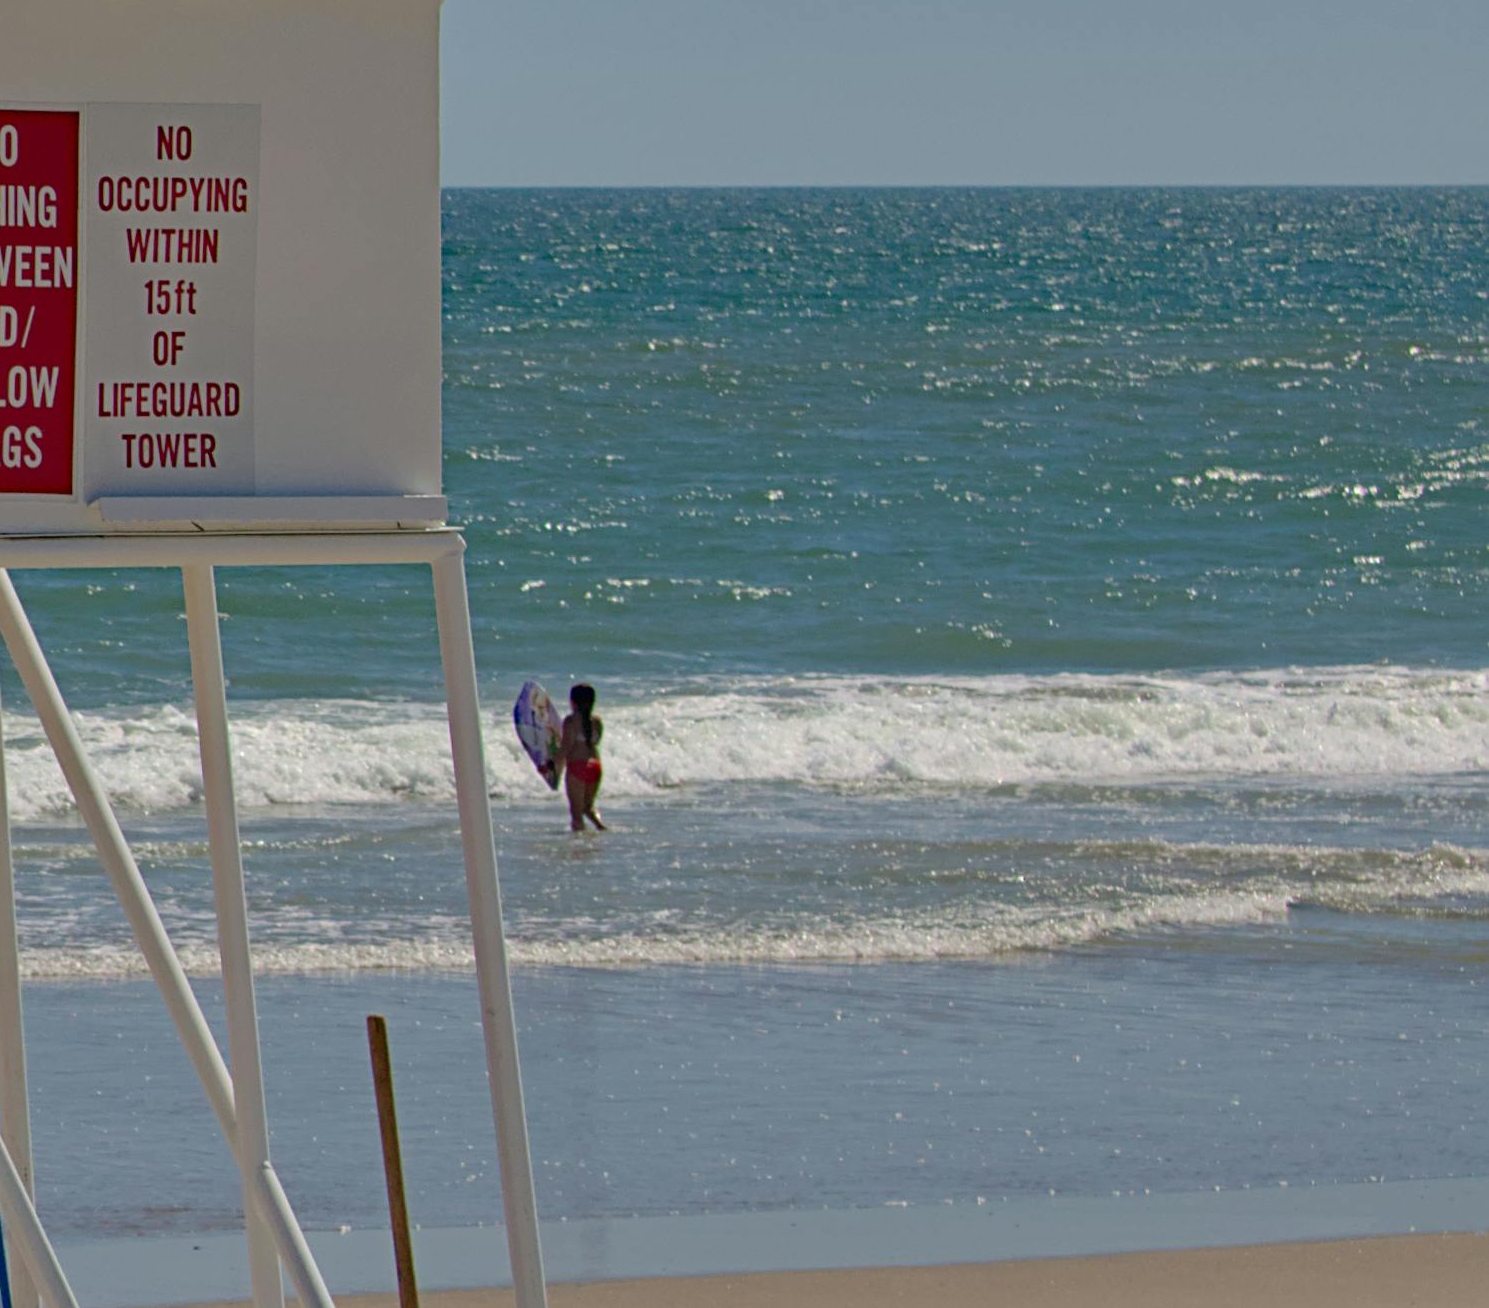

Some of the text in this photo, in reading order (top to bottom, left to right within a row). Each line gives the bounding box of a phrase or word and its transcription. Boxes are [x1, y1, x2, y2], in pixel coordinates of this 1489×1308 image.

[156, 126, 192, 161] NO
[97, 177, 248, 214] OCCUPYING
[126, 228, 218, 264] WITHIN
[144, 279, 197, 315] 15ft
[153, 331, 185, 367] OF
[97, 382, 240, 418] LIFEGUARD
[121, 433, 217, 469] TOWER
